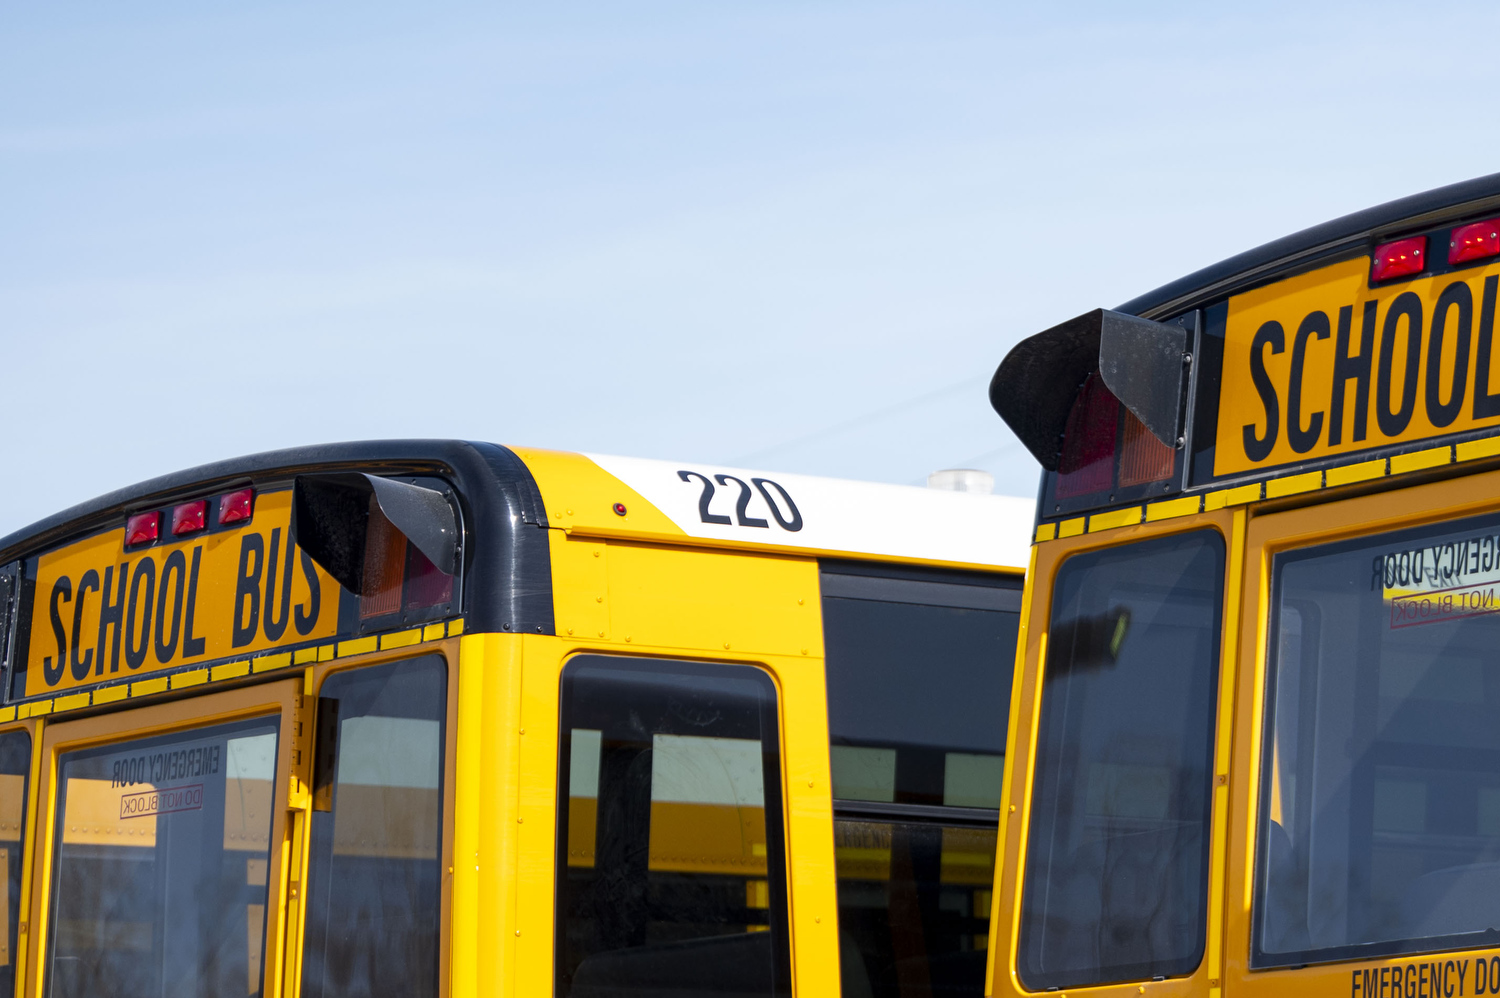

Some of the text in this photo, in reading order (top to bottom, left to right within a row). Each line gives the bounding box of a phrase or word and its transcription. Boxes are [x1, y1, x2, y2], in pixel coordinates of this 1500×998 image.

[677, 470, 803, 532] 220
[43, 525, 321, 687] SCHOOL BUS
